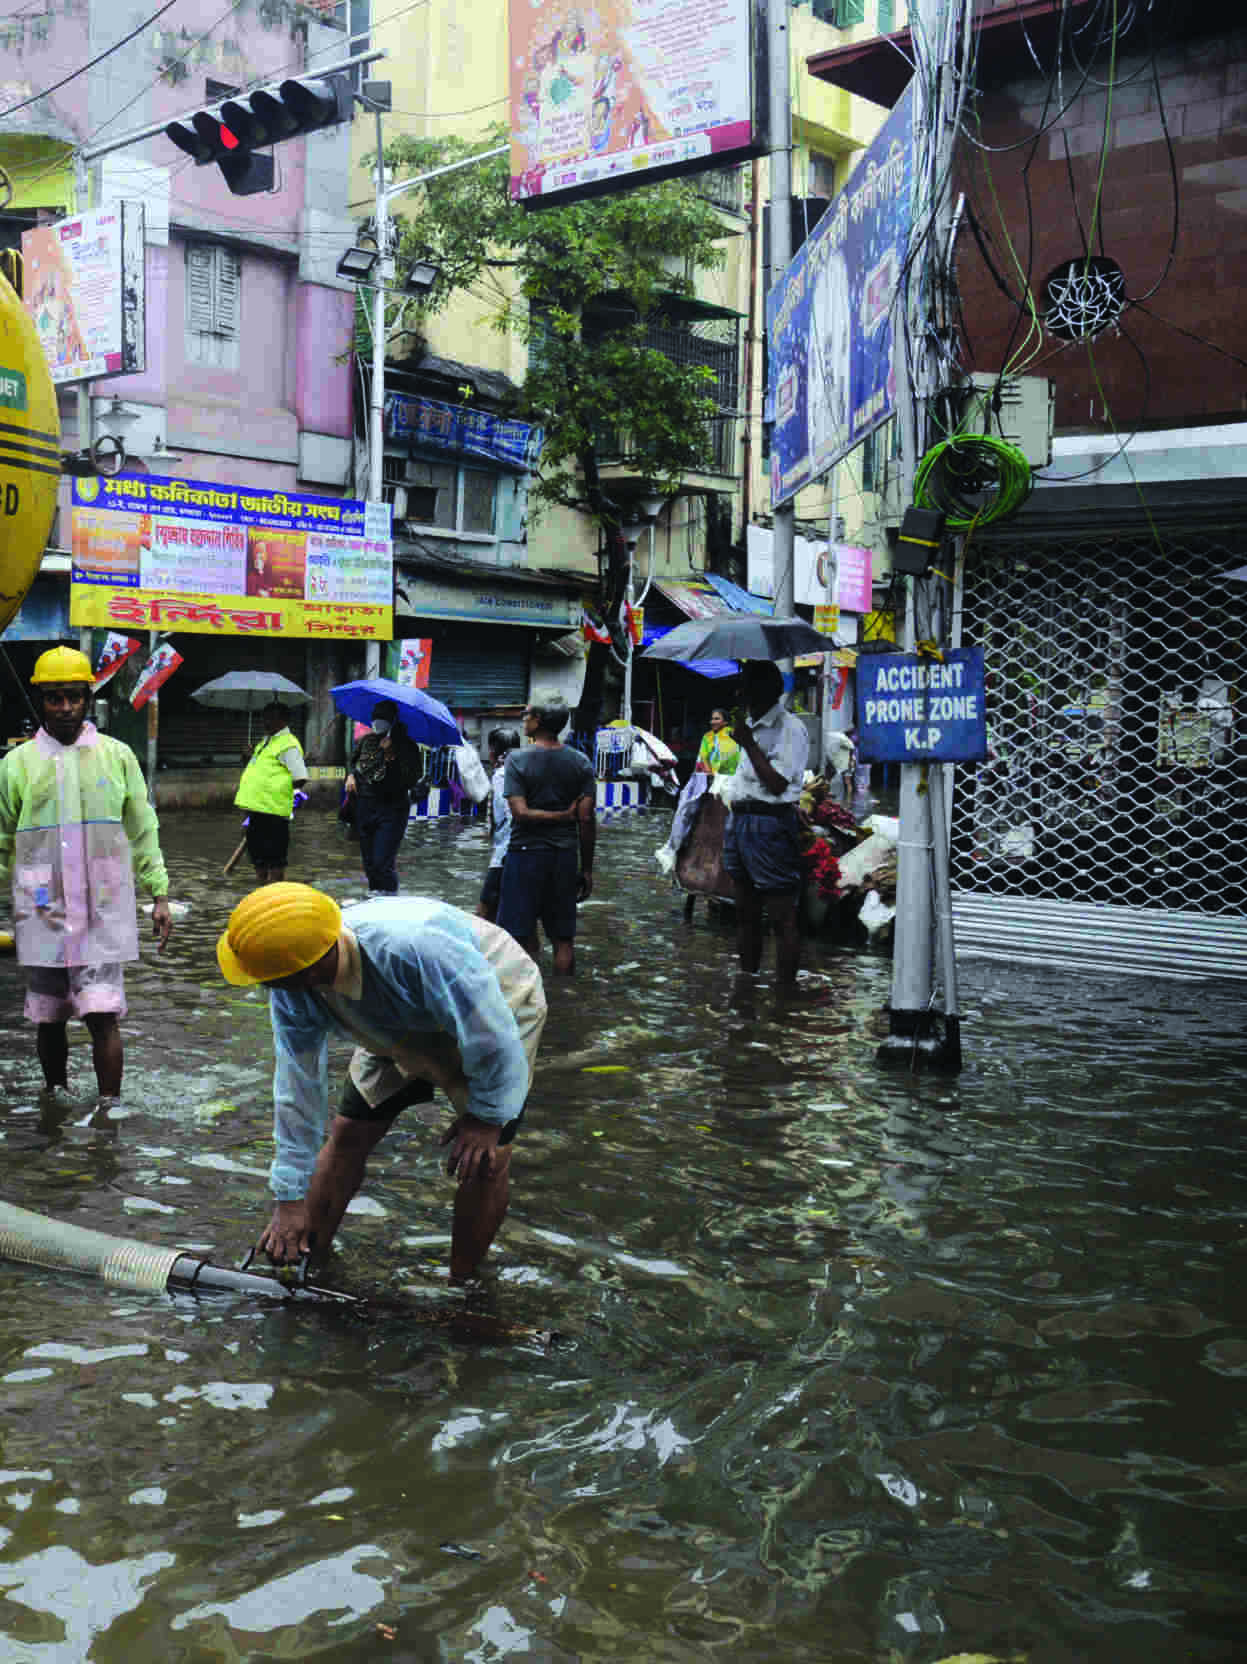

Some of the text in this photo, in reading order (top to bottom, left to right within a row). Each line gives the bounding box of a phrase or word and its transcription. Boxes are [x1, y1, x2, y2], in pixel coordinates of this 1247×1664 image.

[104, 479, 146, 499] মধ্য
[240, 494, 302, 518] জাতীয়
[108, 596, 283, 632] ইন্দিরা
[876, 662, 964, 692] ACCIDENT
[865, 695, 977, 724] PRONE ZONE
[904, 727, 942, 750] K.P
